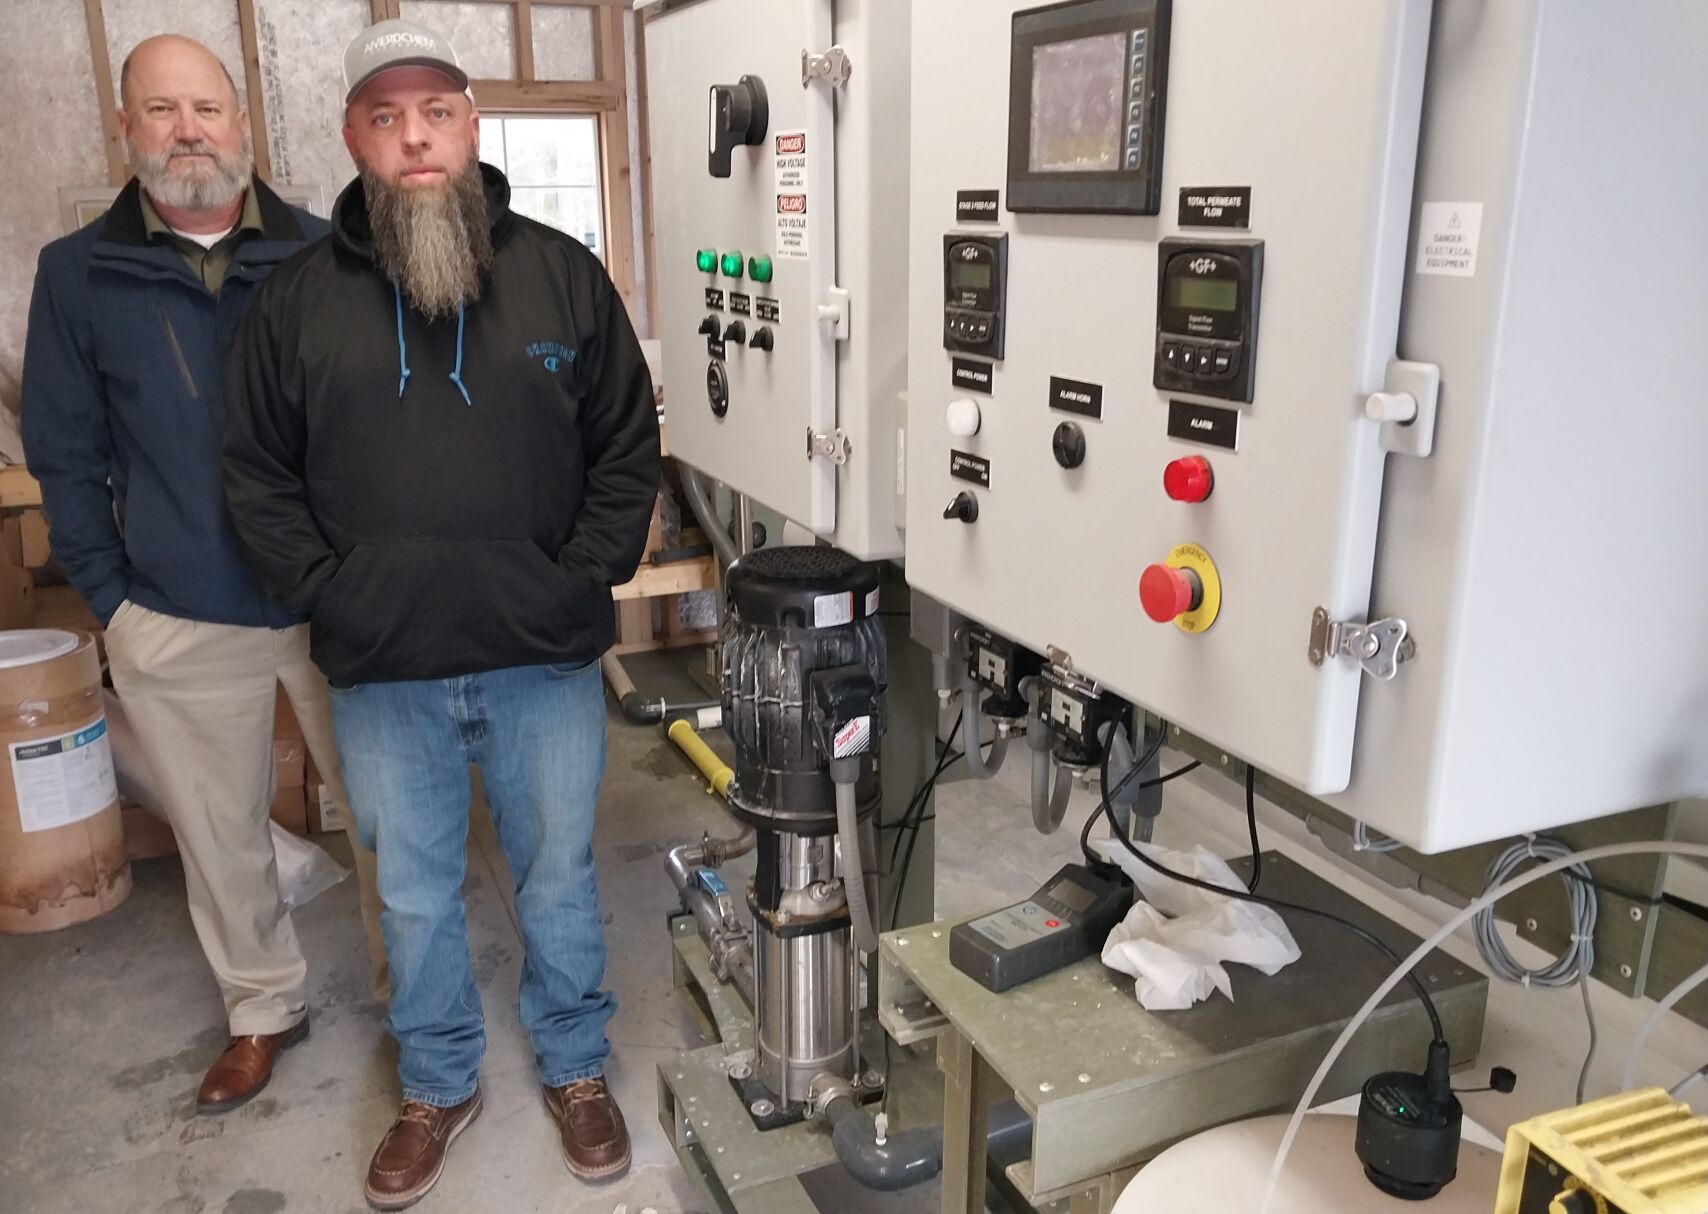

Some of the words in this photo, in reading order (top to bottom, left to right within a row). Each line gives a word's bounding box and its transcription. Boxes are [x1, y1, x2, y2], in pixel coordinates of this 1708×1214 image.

[779, 137, 802, 151] DANGER
[787, 157, 806, 168] VOLTAGE
[780, 197, 803, 210] PELIGRO
[1187, 196, 1206, 206] TOTAL
[1207, 196, 1241, 207] PERMEATE
[1203, 207, 1223, 217] FLOW
[789, 218, 806, 229] VOLTAJE
[956, 368, 973, 380] CONTROL
[973, 371, 988, 382] POWER
[1060, 389, 1077, 401] ALARM
[1076, 392, 1091, 404] HORN
[1190, 418, 1213, 430] ALARM
[955, 455, 971, 468] CONTROL
